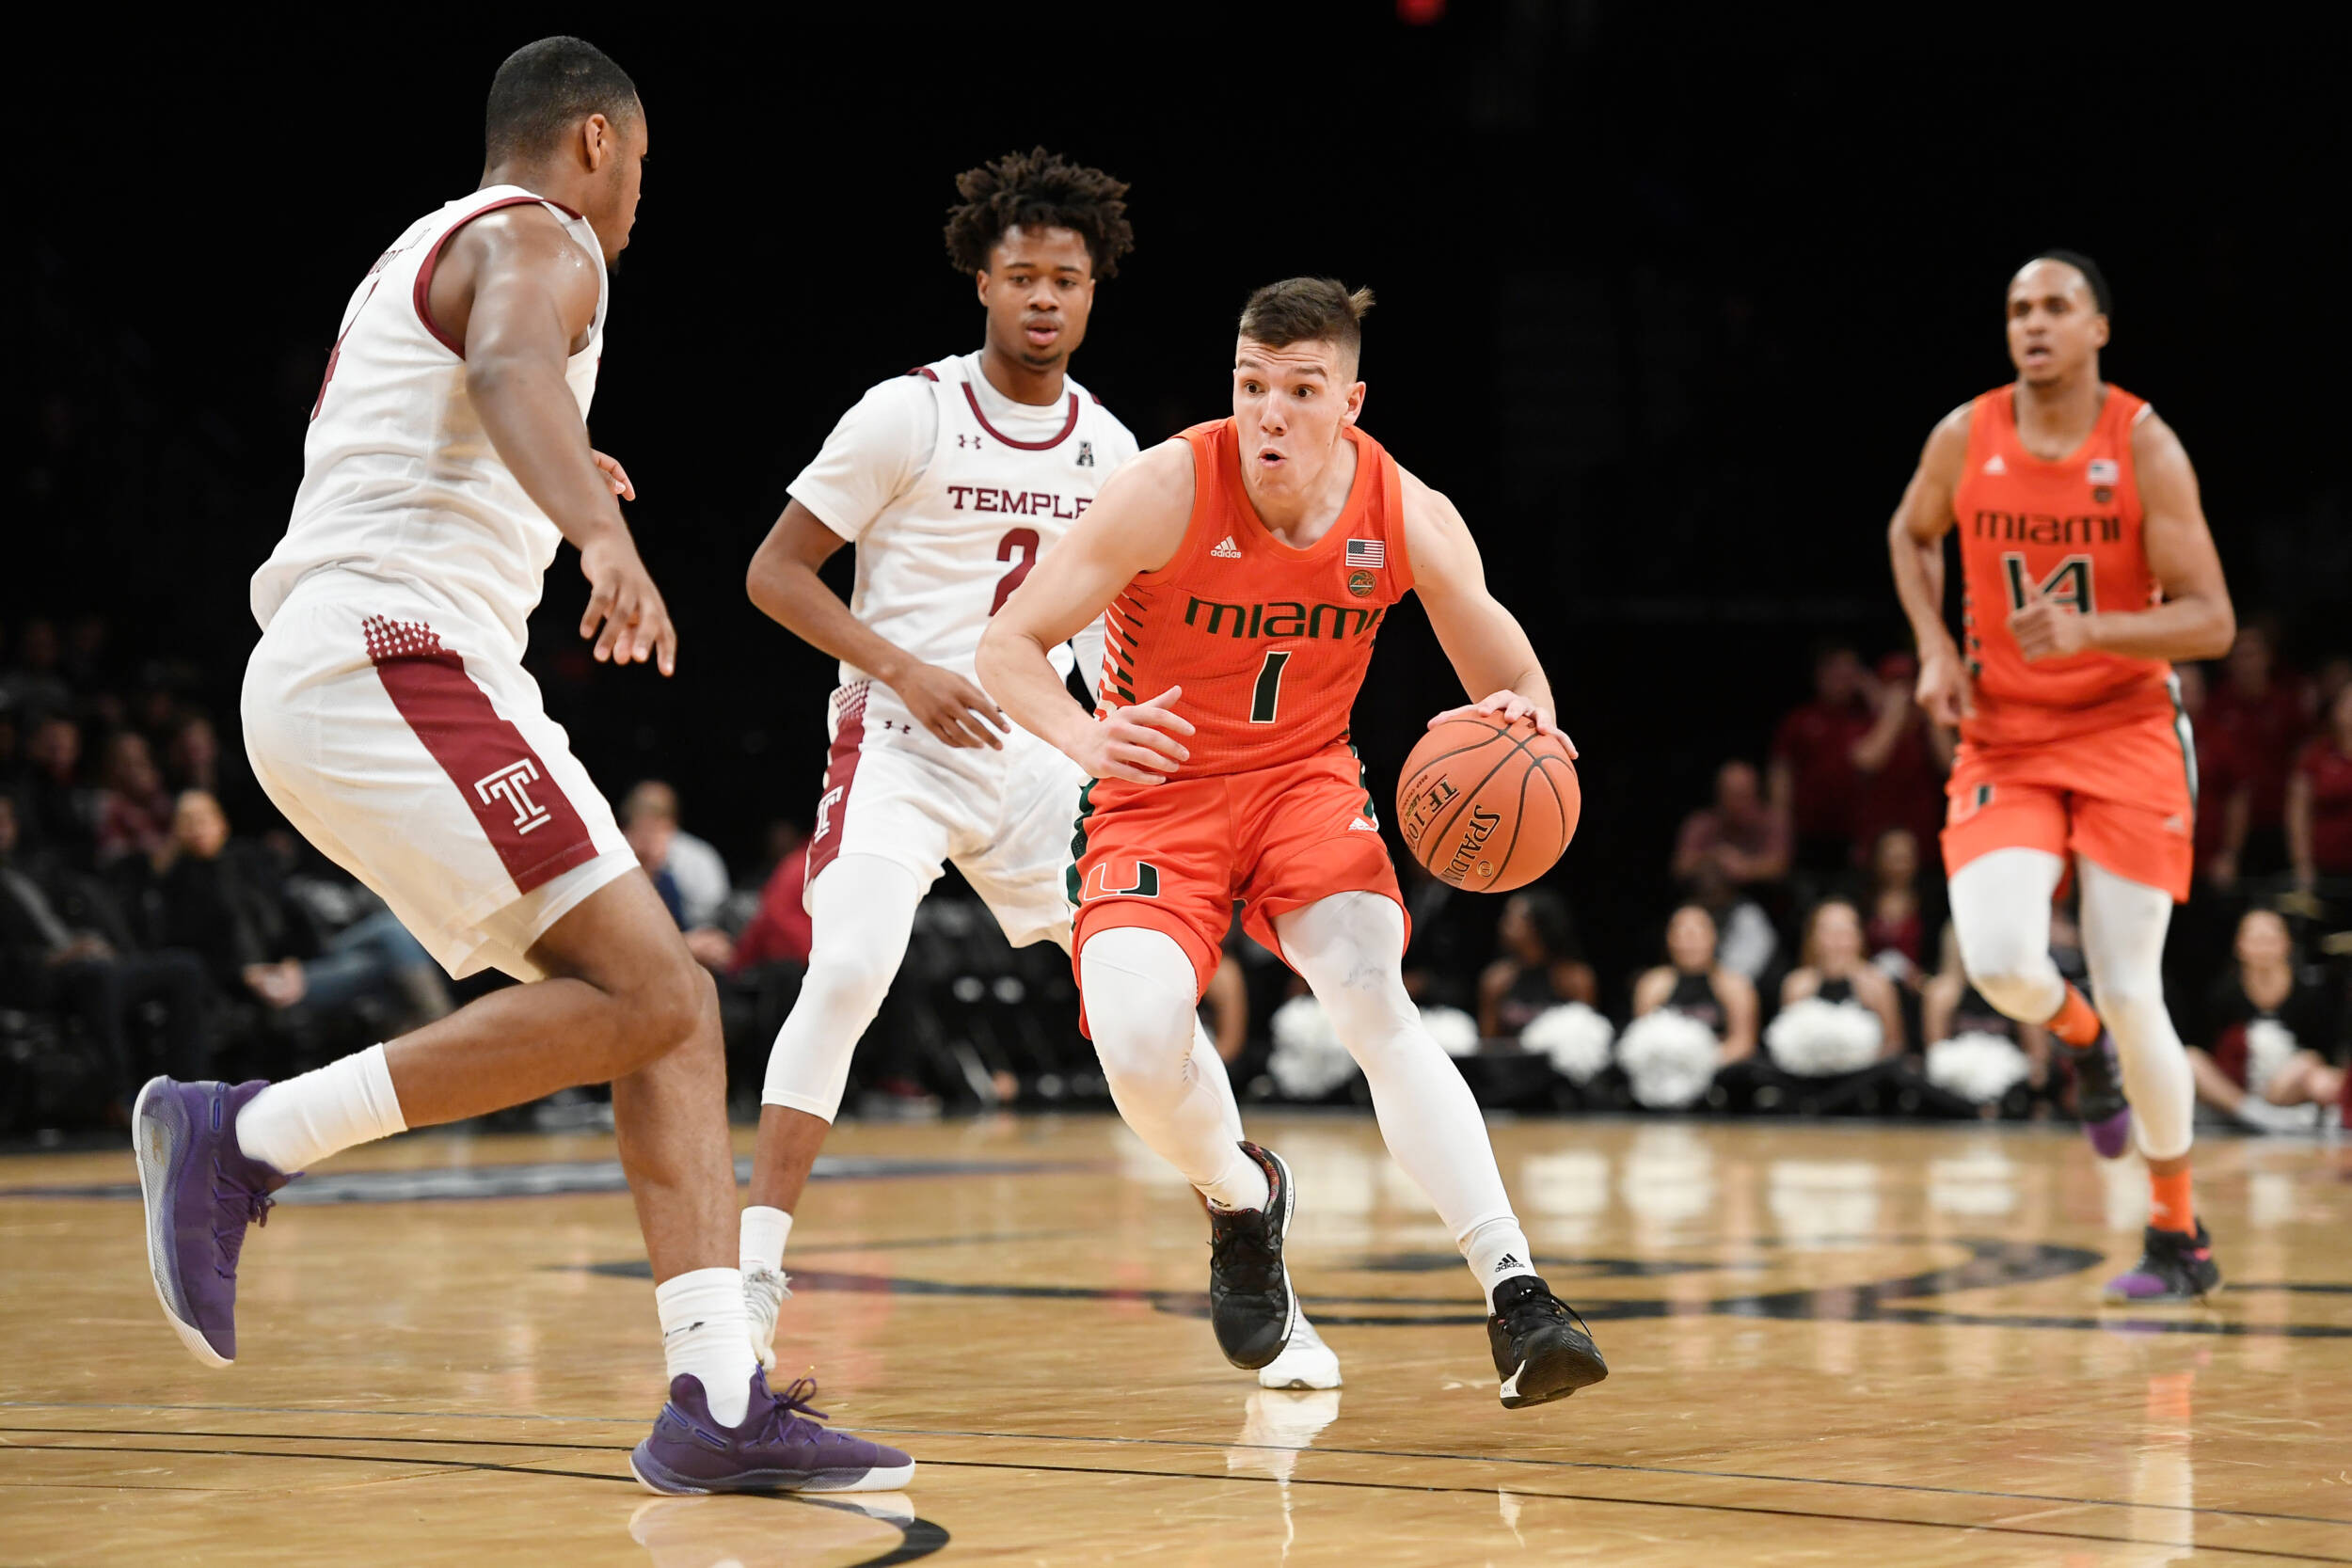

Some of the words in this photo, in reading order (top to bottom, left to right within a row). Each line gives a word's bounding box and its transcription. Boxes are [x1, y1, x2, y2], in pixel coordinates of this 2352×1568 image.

[1210, 549, 1242, 559] adidas
[2000, 551, 2098, 613] 14
[1249, 651, 1292, 723] 1
